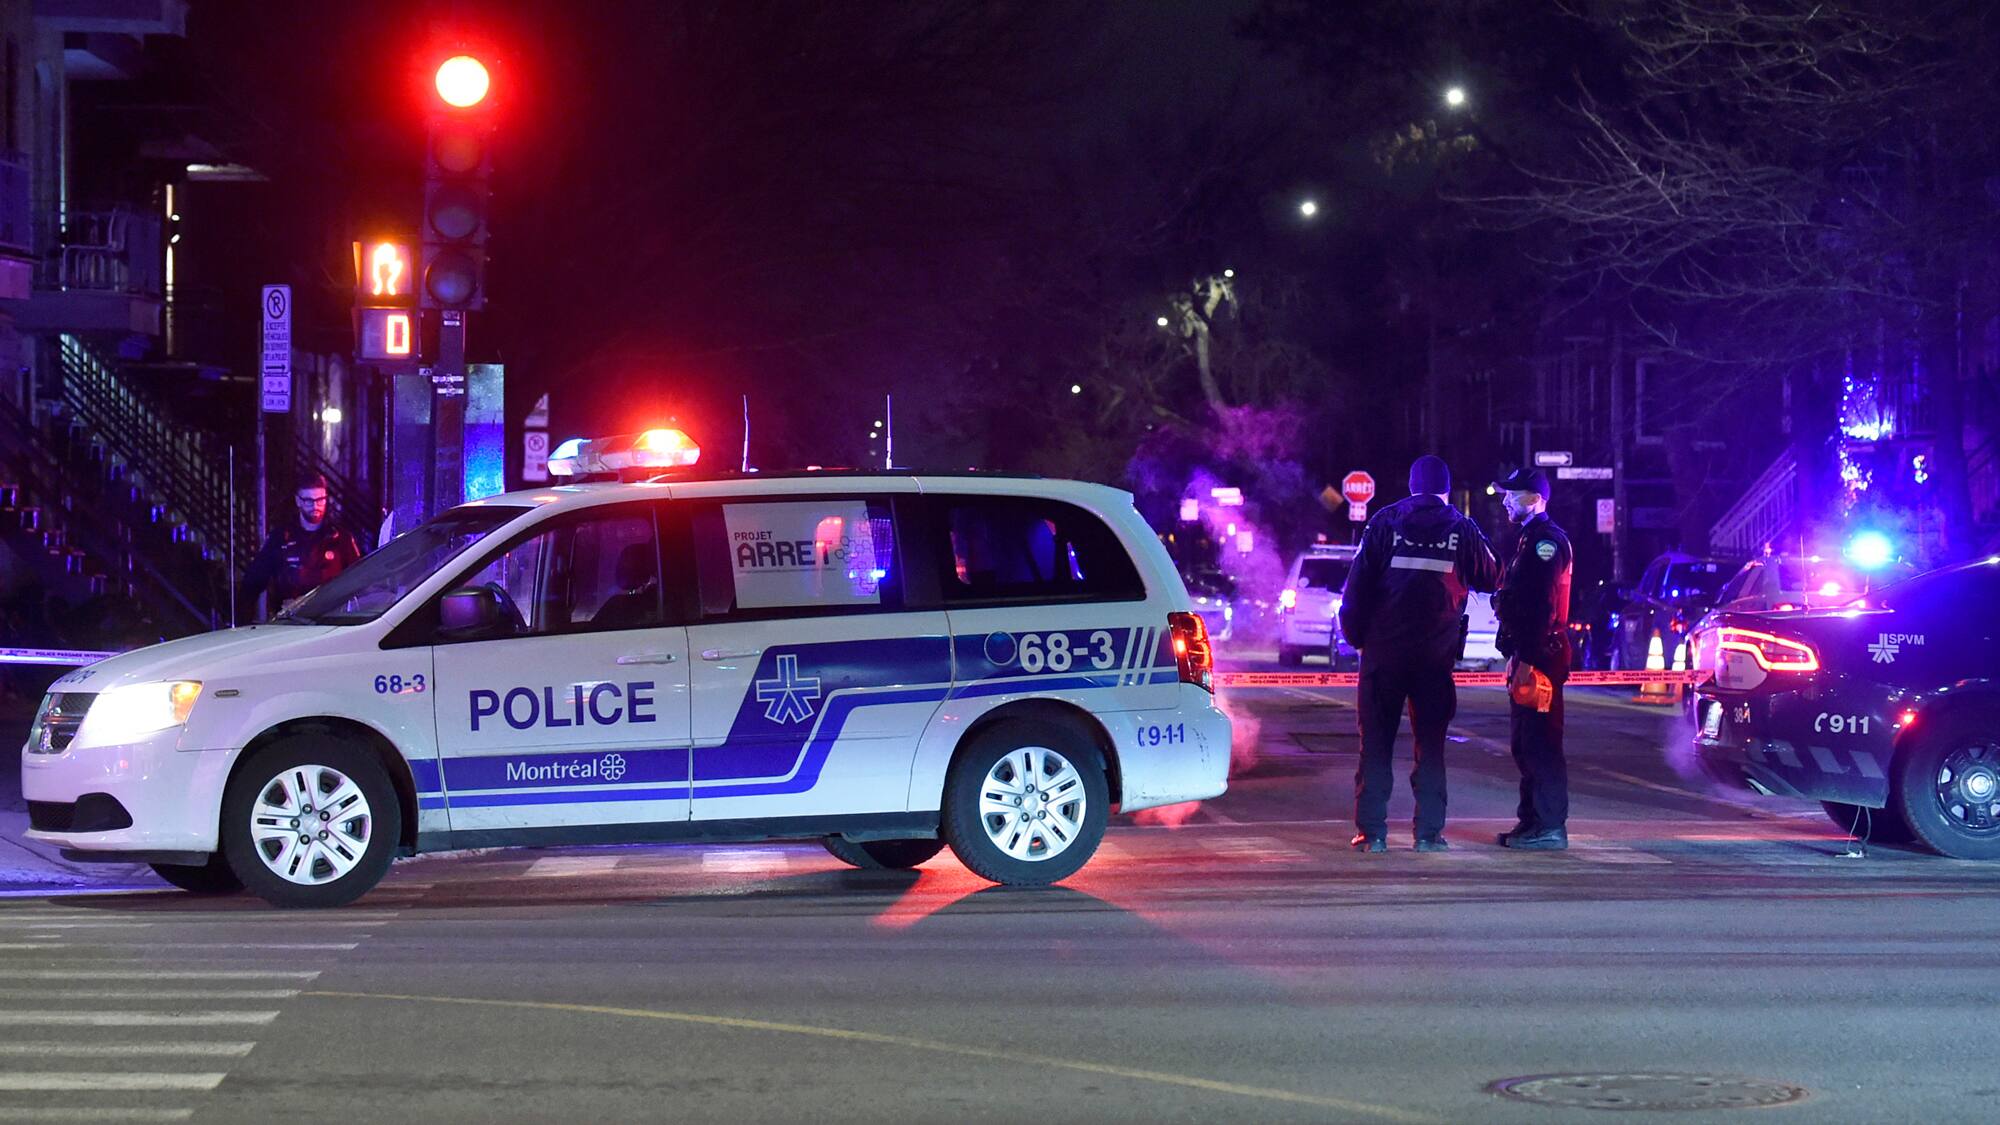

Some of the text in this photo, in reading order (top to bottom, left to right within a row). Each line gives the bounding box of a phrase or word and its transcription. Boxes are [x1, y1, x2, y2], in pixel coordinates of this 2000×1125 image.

[734, 531, 772, 541] PROJET
[736, 540, 832, 567] ARRET
[1888, 633, 1925, 646] SPVM
[1019, 631, 1115, 673] 68-3
[374, 674, 426, 694] 68-3
[469, 681, 657, 731] POLICE
[1148, 723, 1185, 746] 9-1-1
[1829, 714, 1870, 734] 911
[506, 758, 597, 781] Montréal
